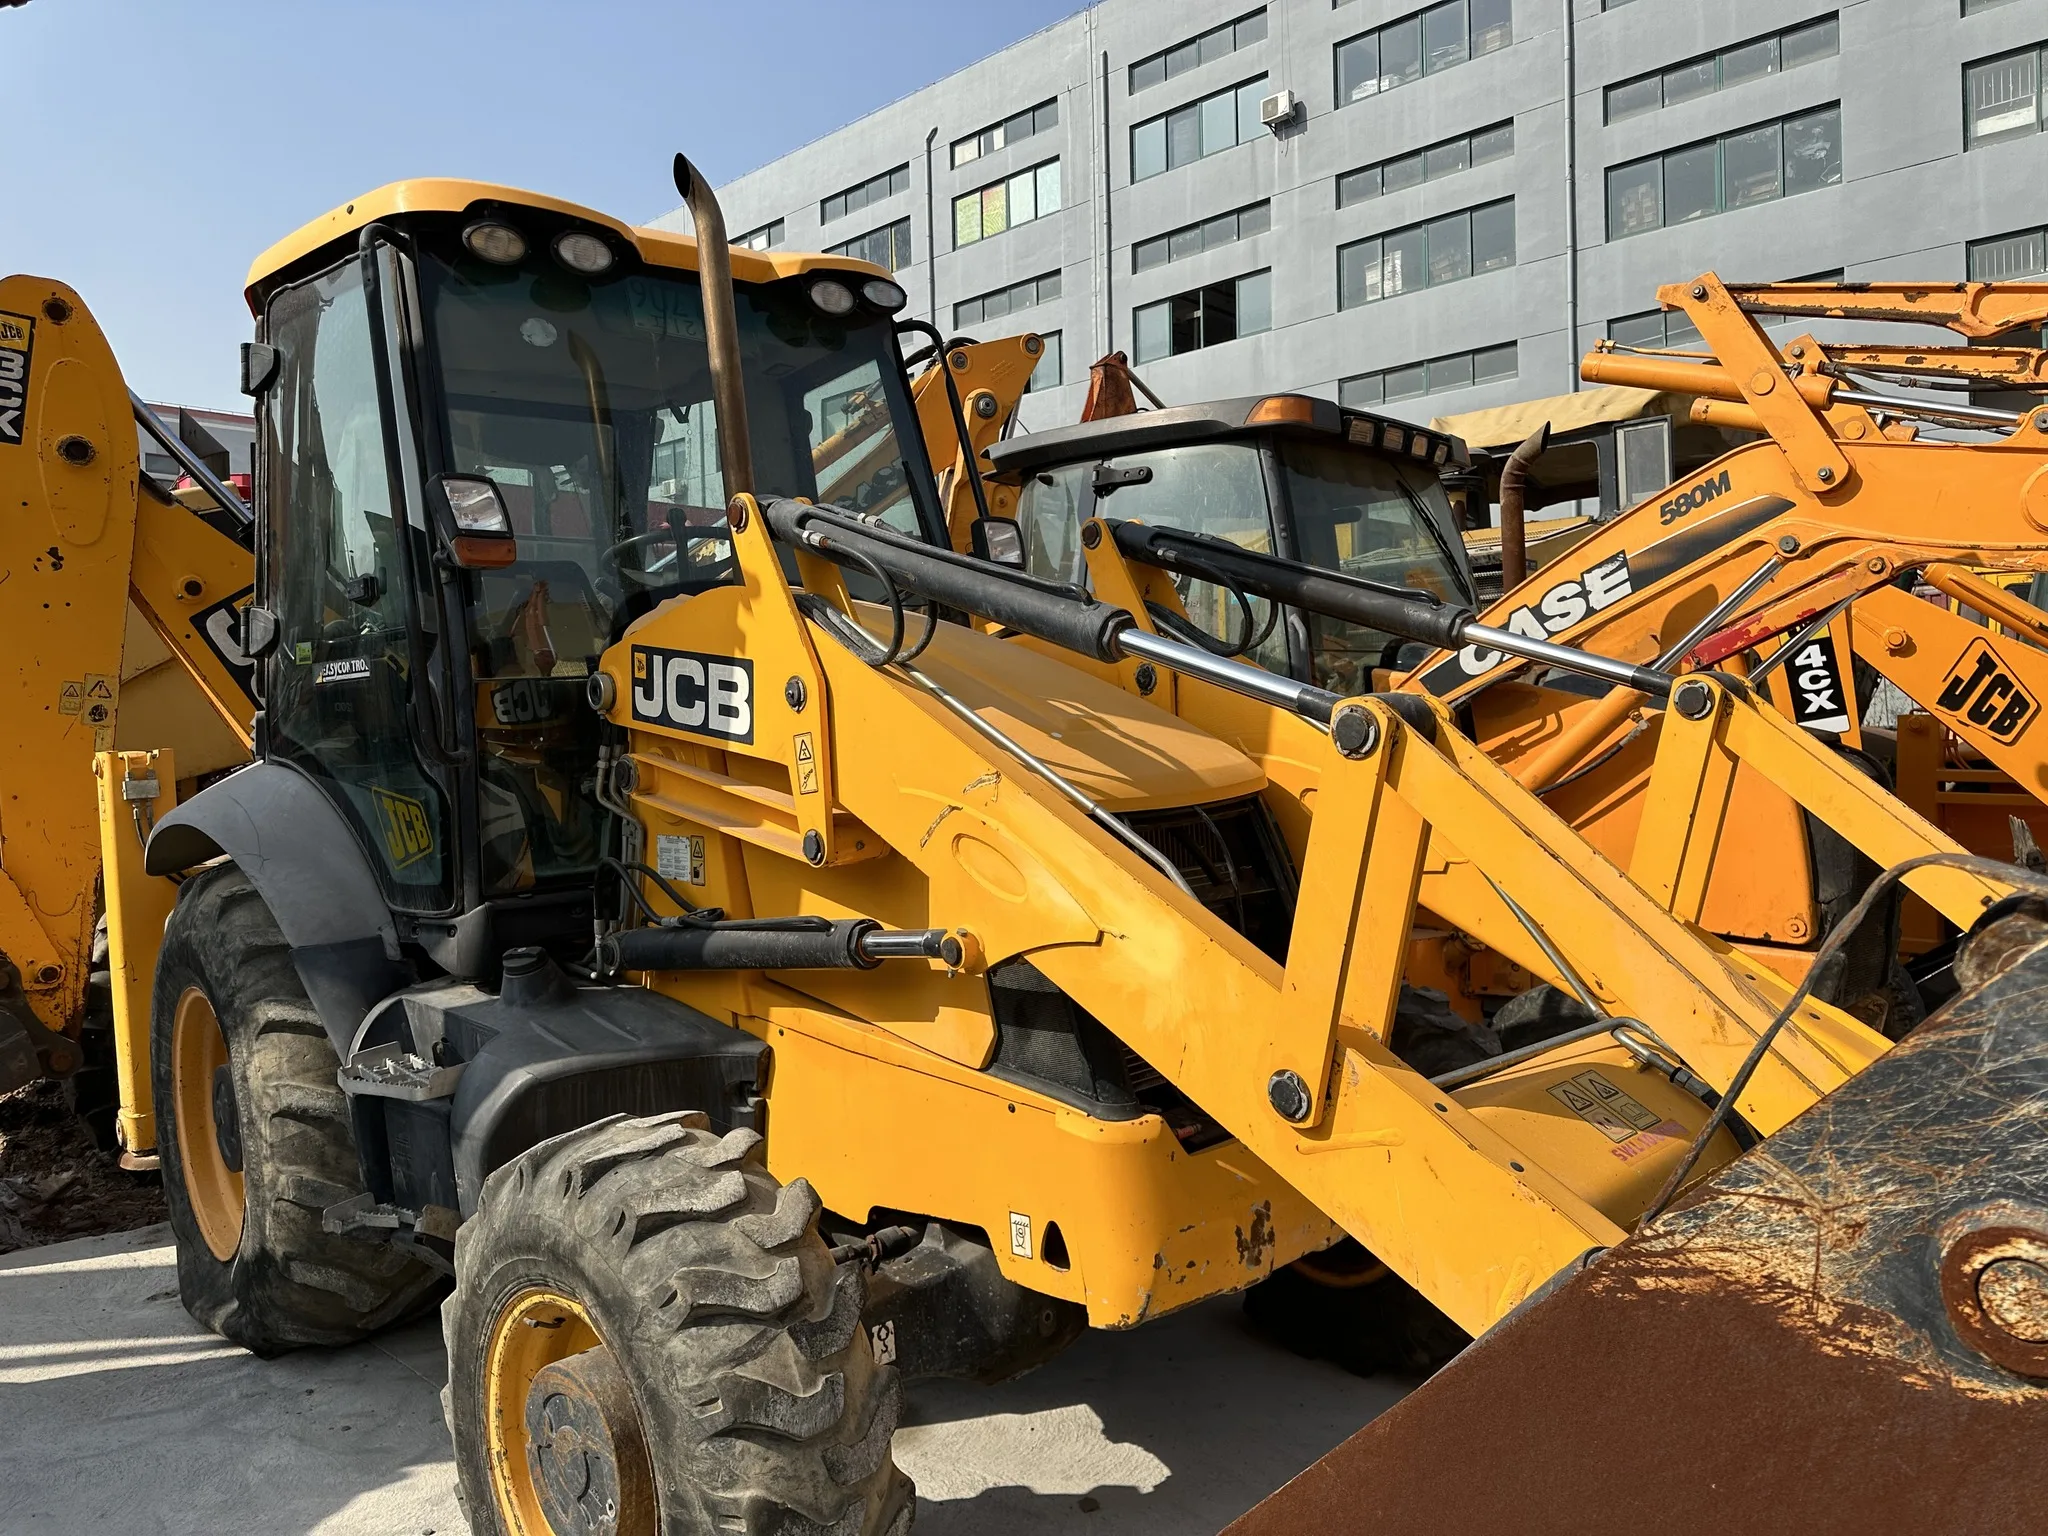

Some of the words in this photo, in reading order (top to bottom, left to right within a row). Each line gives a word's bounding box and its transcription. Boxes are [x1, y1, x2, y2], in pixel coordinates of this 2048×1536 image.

[1, 322, 24, 340] JCB
[1660, 469, 1732, 525] 580M
[1458, 553, 1632, 676] CASE
[634, 654, 751, 736] JCB
[1794, 643, 1839, 714] 4CX
[1935, 649, 2031, 736] JCB
[381, 796, 430, 861] JCB
